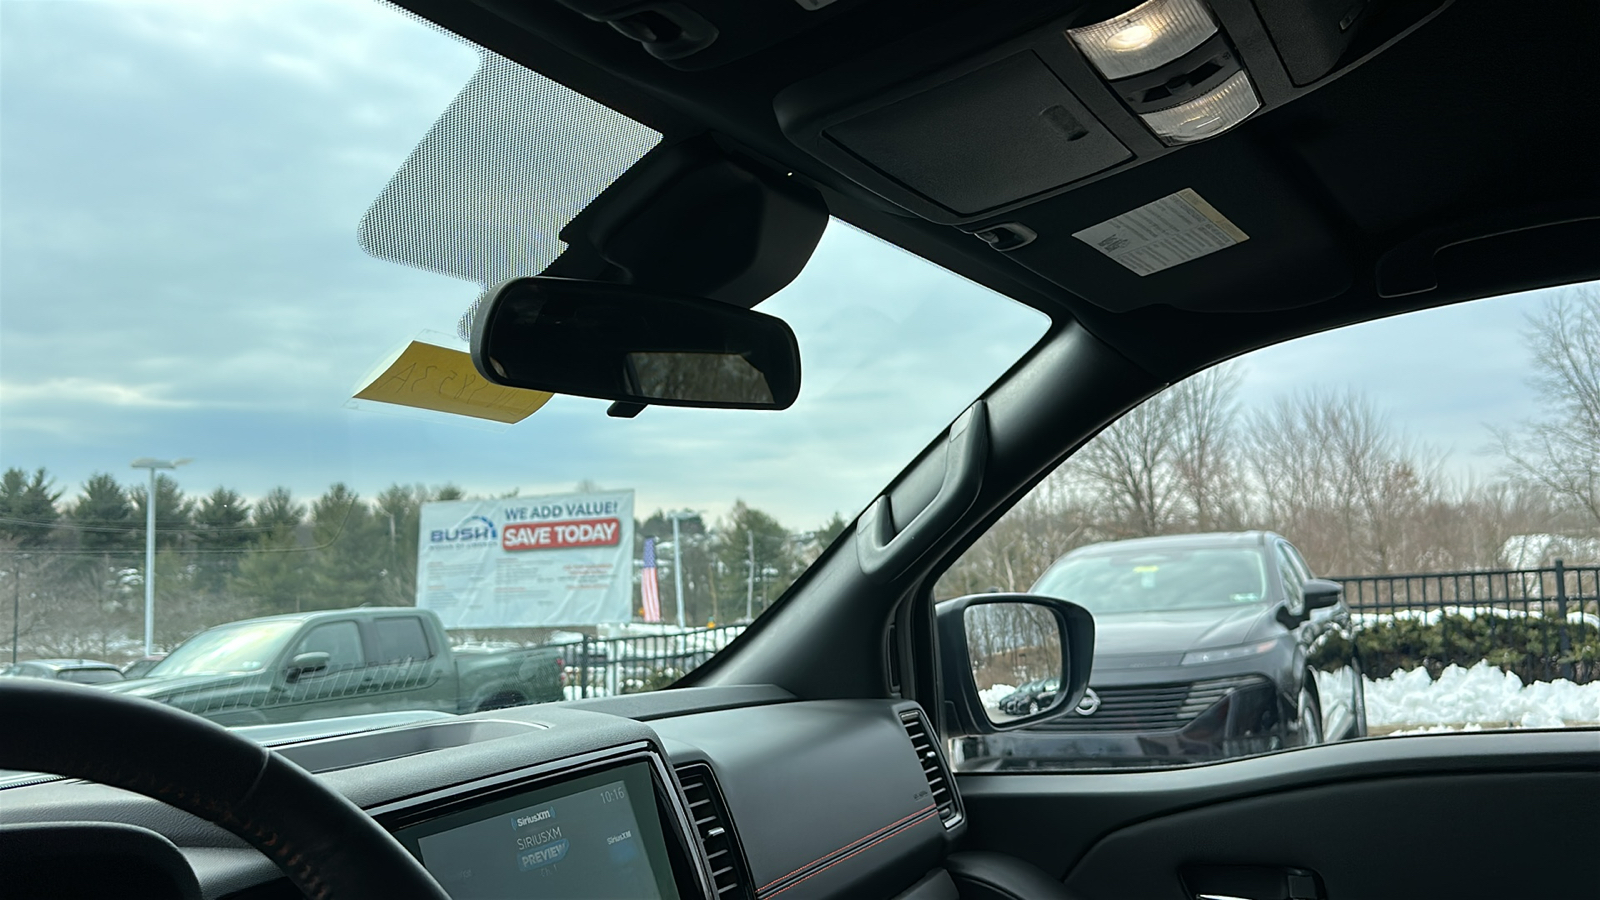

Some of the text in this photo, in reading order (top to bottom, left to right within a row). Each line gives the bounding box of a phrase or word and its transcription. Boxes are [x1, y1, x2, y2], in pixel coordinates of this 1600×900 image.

[505, 501, 618, 520] WE ADD VALUE!
[430, 526, 489, 542] BUSH
[504, 526, 552, 547] SAVE
[554, 522, 617, 543] TODAY
[600, 786, 625, 804] 10:16
[516, 826, 562, 851] SIRIUSXM
[521, 842, 566, 868] PREVIEW
